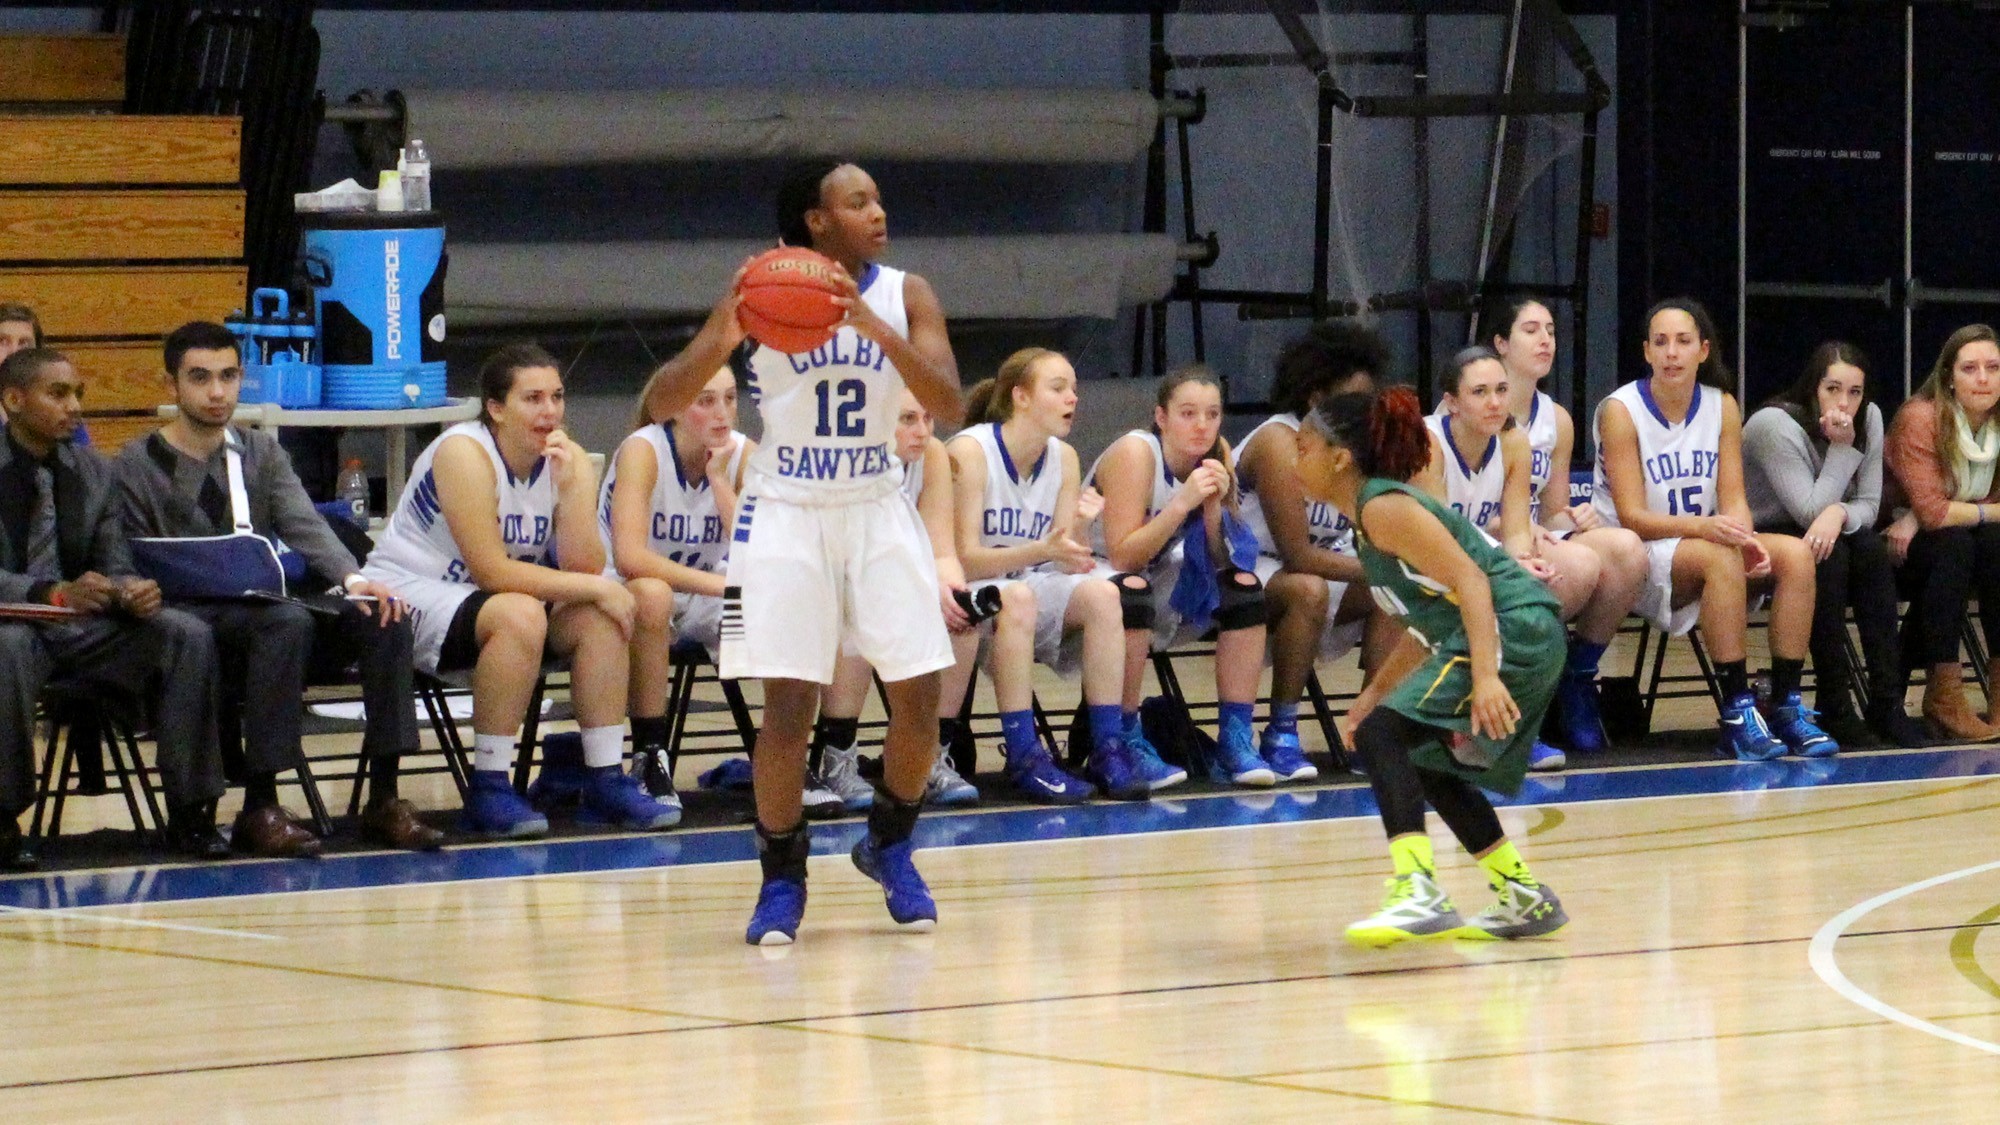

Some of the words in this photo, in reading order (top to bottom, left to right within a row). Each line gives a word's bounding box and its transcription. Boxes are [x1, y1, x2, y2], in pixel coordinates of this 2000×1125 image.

[385, 240, 401, 360] POWERADE
[815, 379, 866, 437] 12
[777, 441, 891, 480] SAWYER
[1646, 450, 1719, 484] COLBY
[352, 500, 364, 514] G
[1668, 486, 1702, 516] 15
[497, 512, 549, 546] OLB
